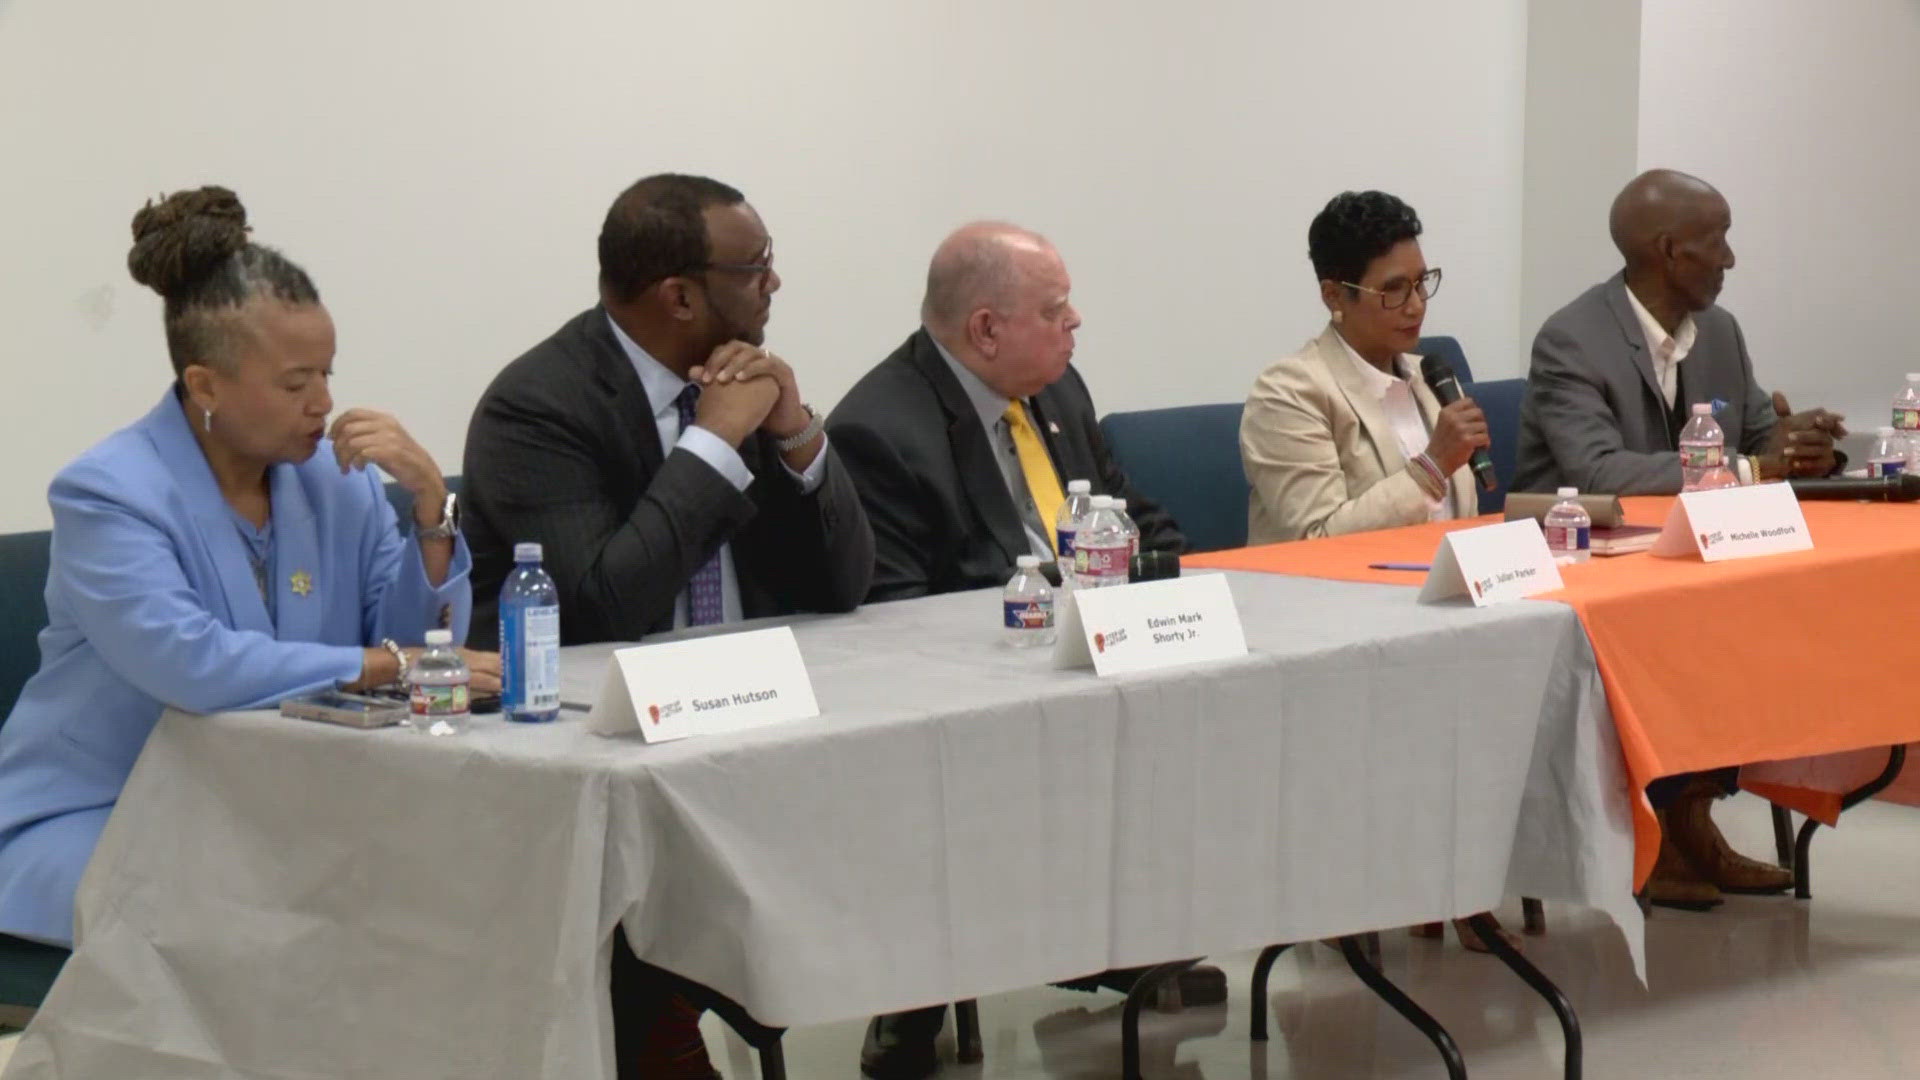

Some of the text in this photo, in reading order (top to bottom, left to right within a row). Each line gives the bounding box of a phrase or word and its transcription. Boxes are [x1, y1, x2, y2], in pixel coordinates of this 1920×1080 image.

[1730, 531, 1759, 541] Michelle
[1760, 526, 1795, 537] Woodfork
[1515, 568, 1536, 577] Parker
[1147, 612, 1202, 629] Edwin Mark
[1153, 629, 1200, 644] Shorty Jr.
[692, 697, 730, 711] Susan
[732, 689, 777, 705] Hutson
